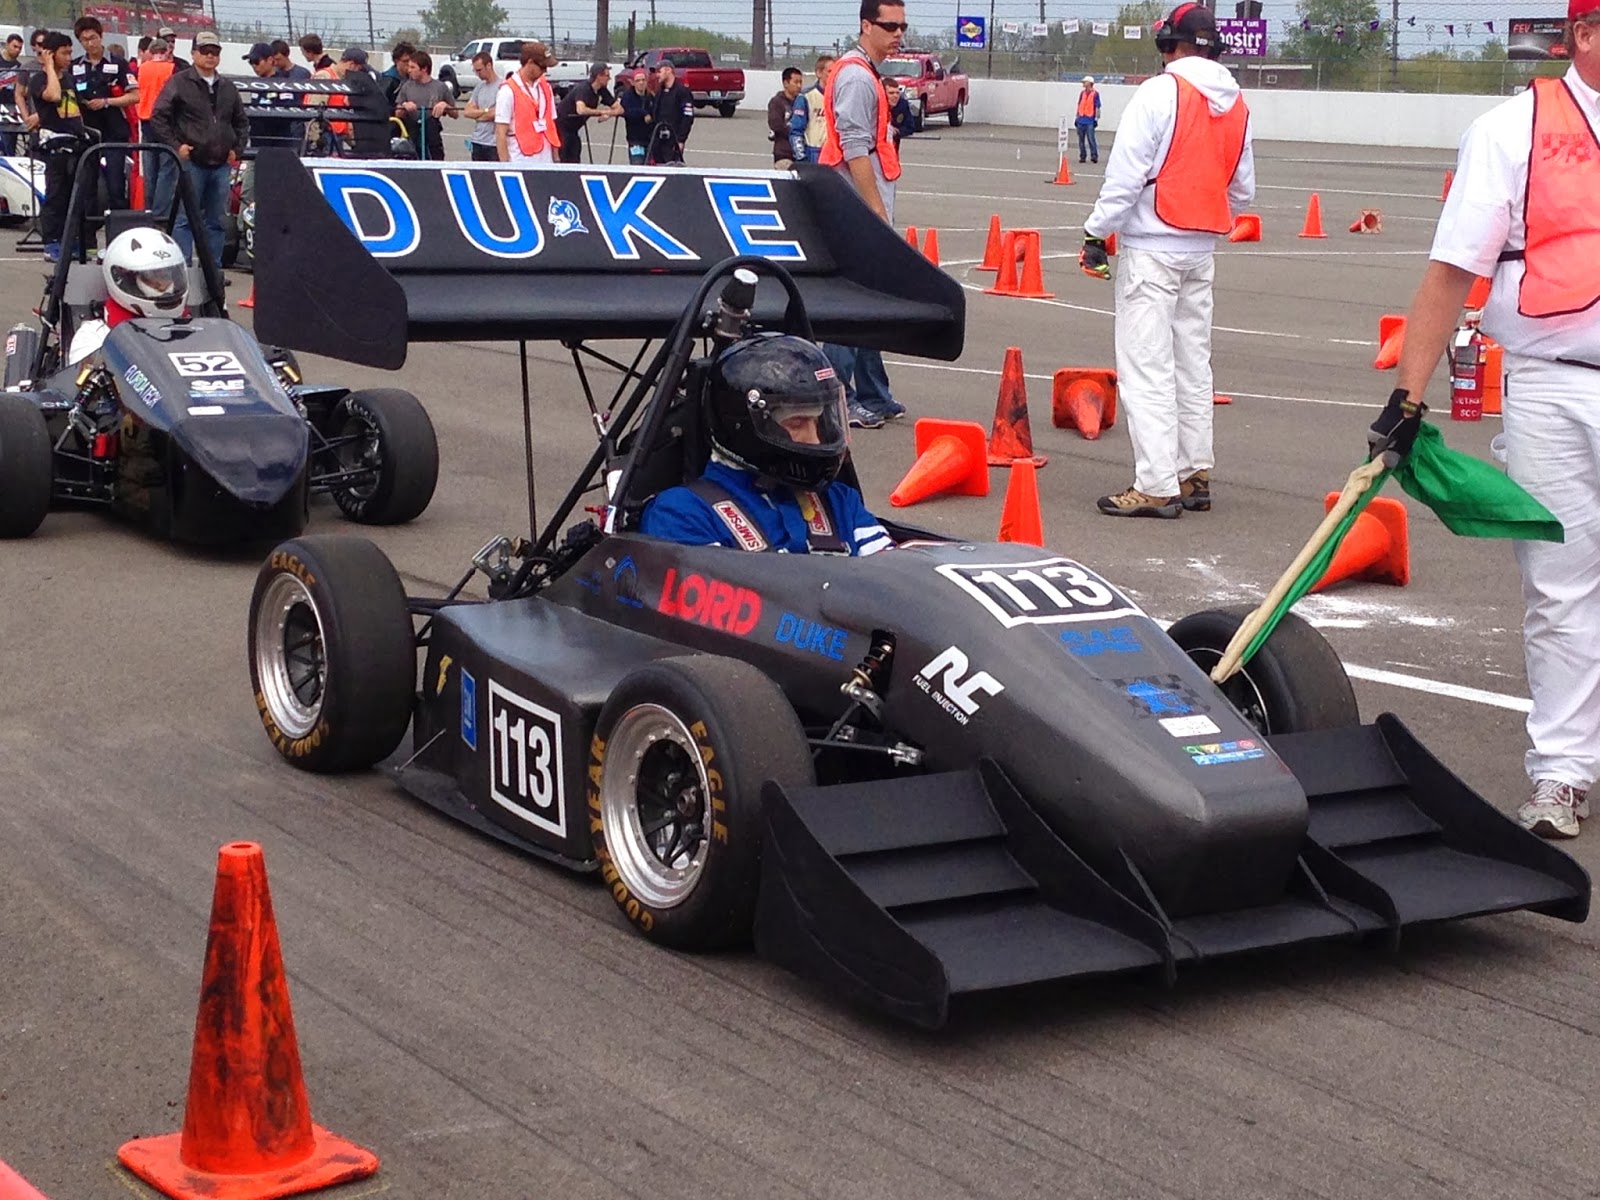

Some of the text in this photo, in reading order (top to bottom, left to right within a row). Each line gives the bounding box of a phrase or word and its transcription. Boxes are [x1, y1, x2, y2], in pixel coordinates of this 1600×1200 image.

[233, 81, 351, 92] OOKMIN
[312, 168, 807, 261] DUKE
[176, 355, 241, 372] 52
[191, 380, 244, 390] SAE
[721, 506, 760, 548] SIMPSON
[272, 551, 315, 586] EAGLE
[973, 566, 1113, 611] 113
[657, 567, 762, 636] LORD
[775, 612, 848, 661] DUKE
[912, 674, 969, 726] FUEL INJECTION
[494, 708, 552, 809] 113
[690, 720, 728, 846] EAGLE
